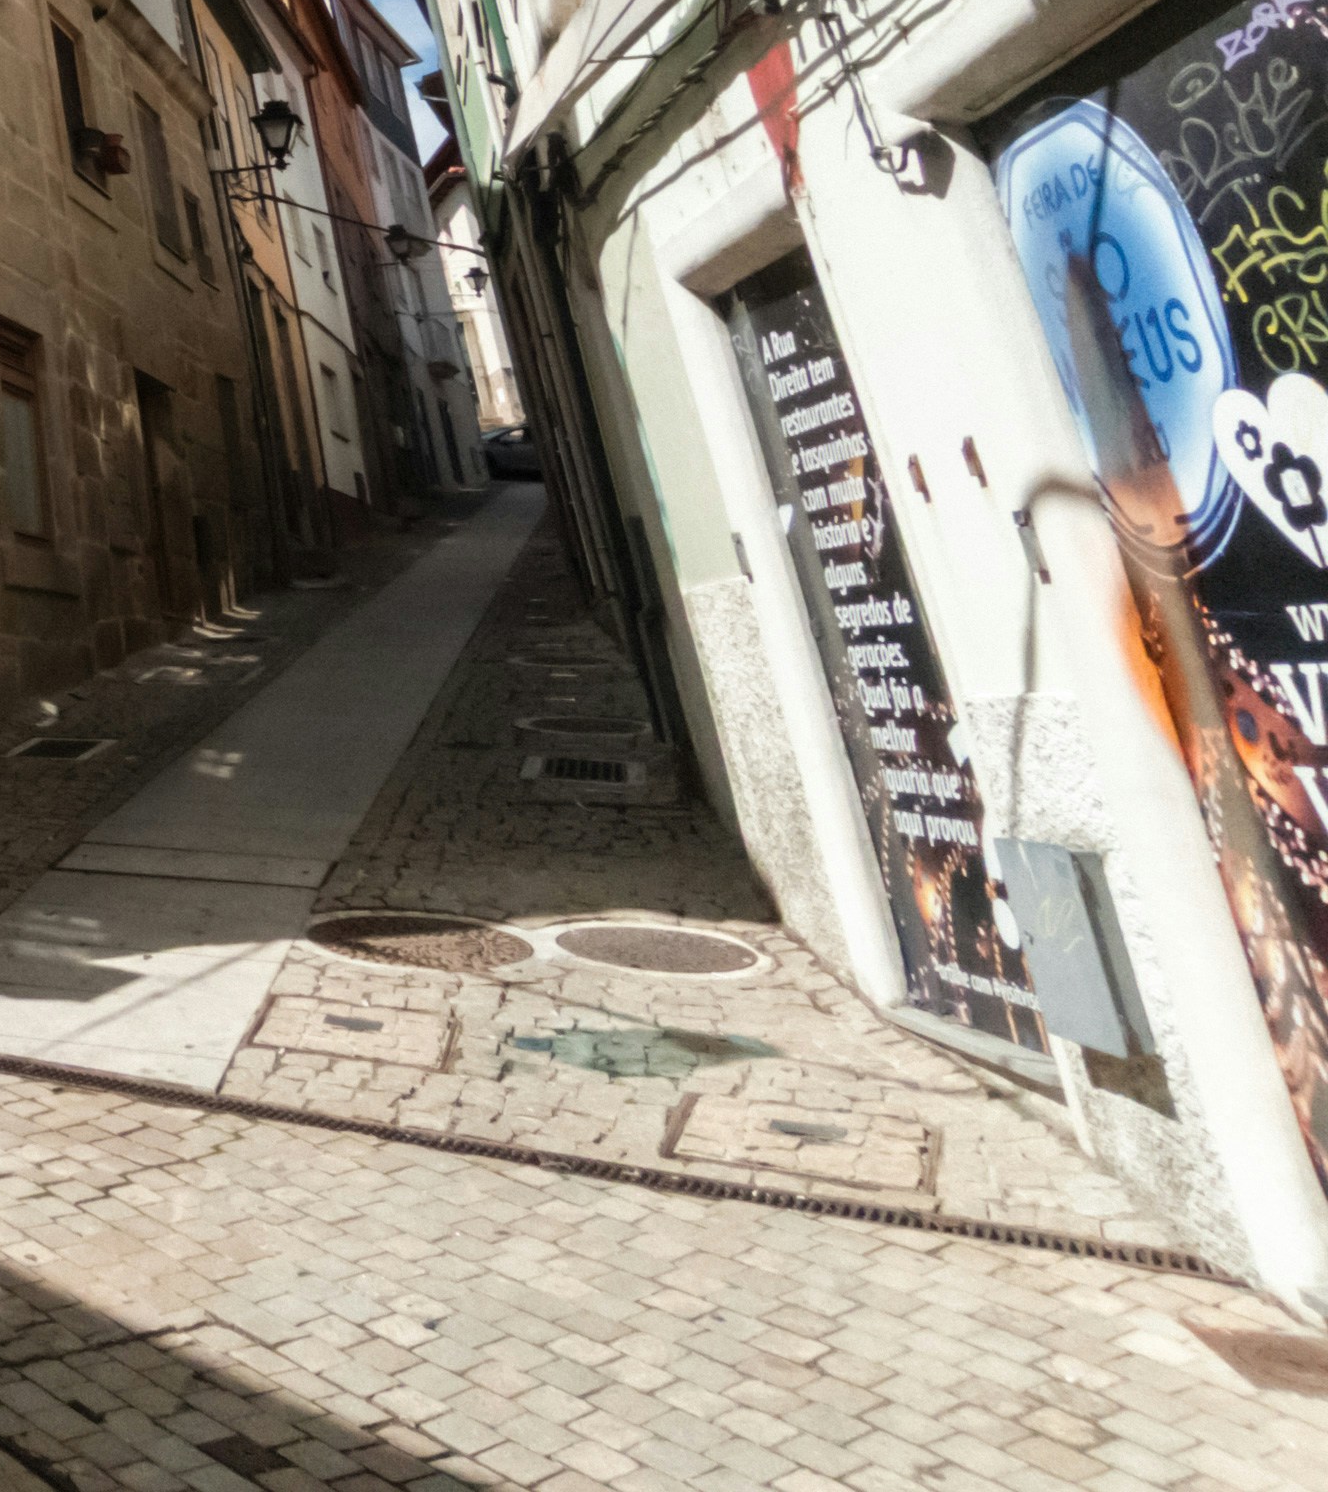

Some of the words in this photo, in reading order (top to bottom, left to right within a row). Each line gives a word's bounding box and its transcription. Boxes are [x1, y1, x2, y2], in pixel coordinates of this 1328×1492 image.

[1023, 174, 1072, 228] FEIRA
[761, 335, 774, 365] A
[769, 330, 797, 360] Rua
[768, 364, 810, 402] Direita
[808, 356, 835, 386] tem
[780, 392, 855, 438] restaurantes
[791, 453, 801, 476] e
[799, 430, 868, 474] tasquinhas
[802, 487, 829, 512] com
[826, 472, 867, 507] muita
[861, 518, 872, 542] e
[824, 559, 868, 596] alguns
[834, 595, 892, 635] segredos
[893, 591, 914, 625] de
[847, 634, 910, 676] gerações.
[857, 677, 892, 717] Qual
[890, 677, 912, 718] foi
[912, 685, 925, 711] a
[869, 719, 917, 752] melhor
[931, 772, 962, 807] que
[894, 805, 925, 843] aqui
